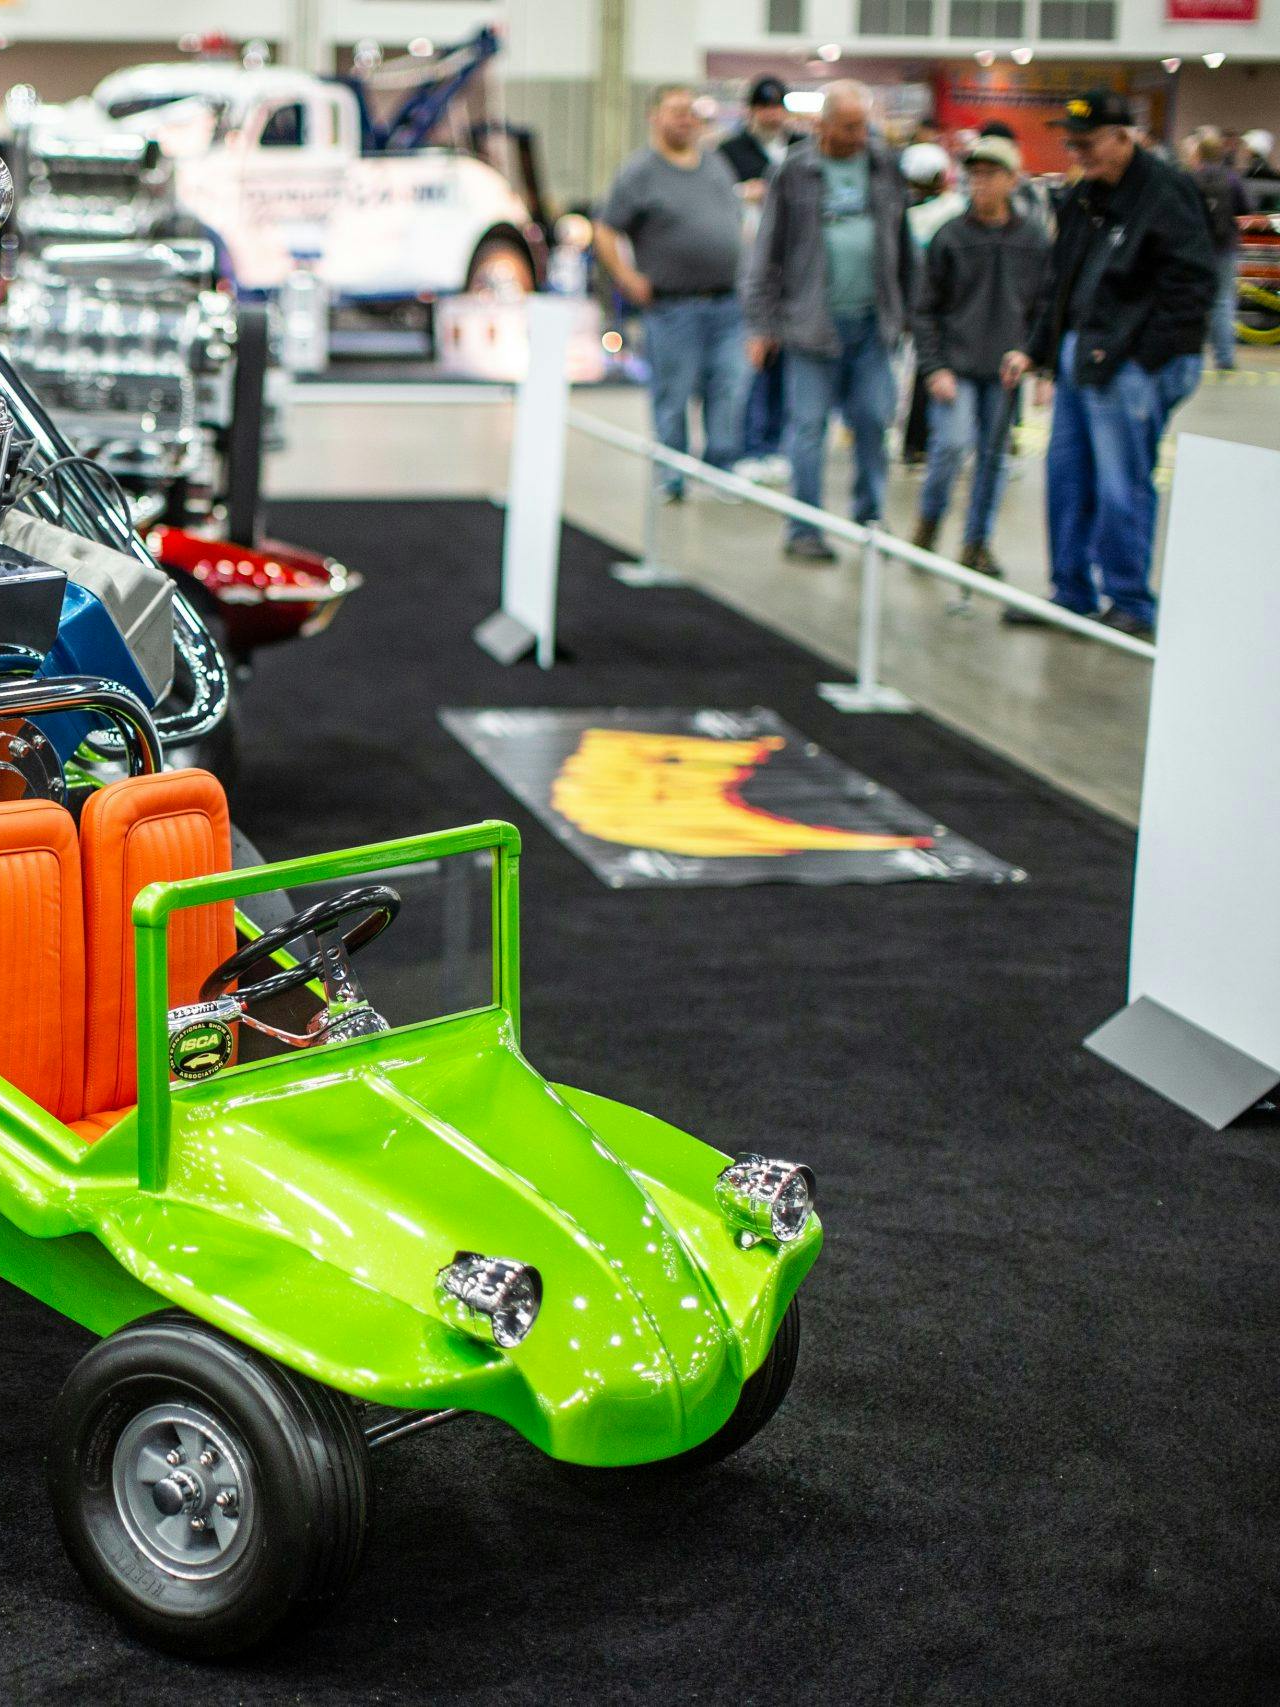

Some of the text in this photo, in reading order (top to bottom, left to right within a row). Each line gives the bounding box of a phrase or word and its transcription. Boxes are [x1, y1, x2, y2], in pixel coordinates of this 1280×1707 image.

[208, 1022, 227, 1034] SHOW
[180, 1033, 220, 1053] ISCA
[179, 1061, 224, 1079] ASSOCIATION
